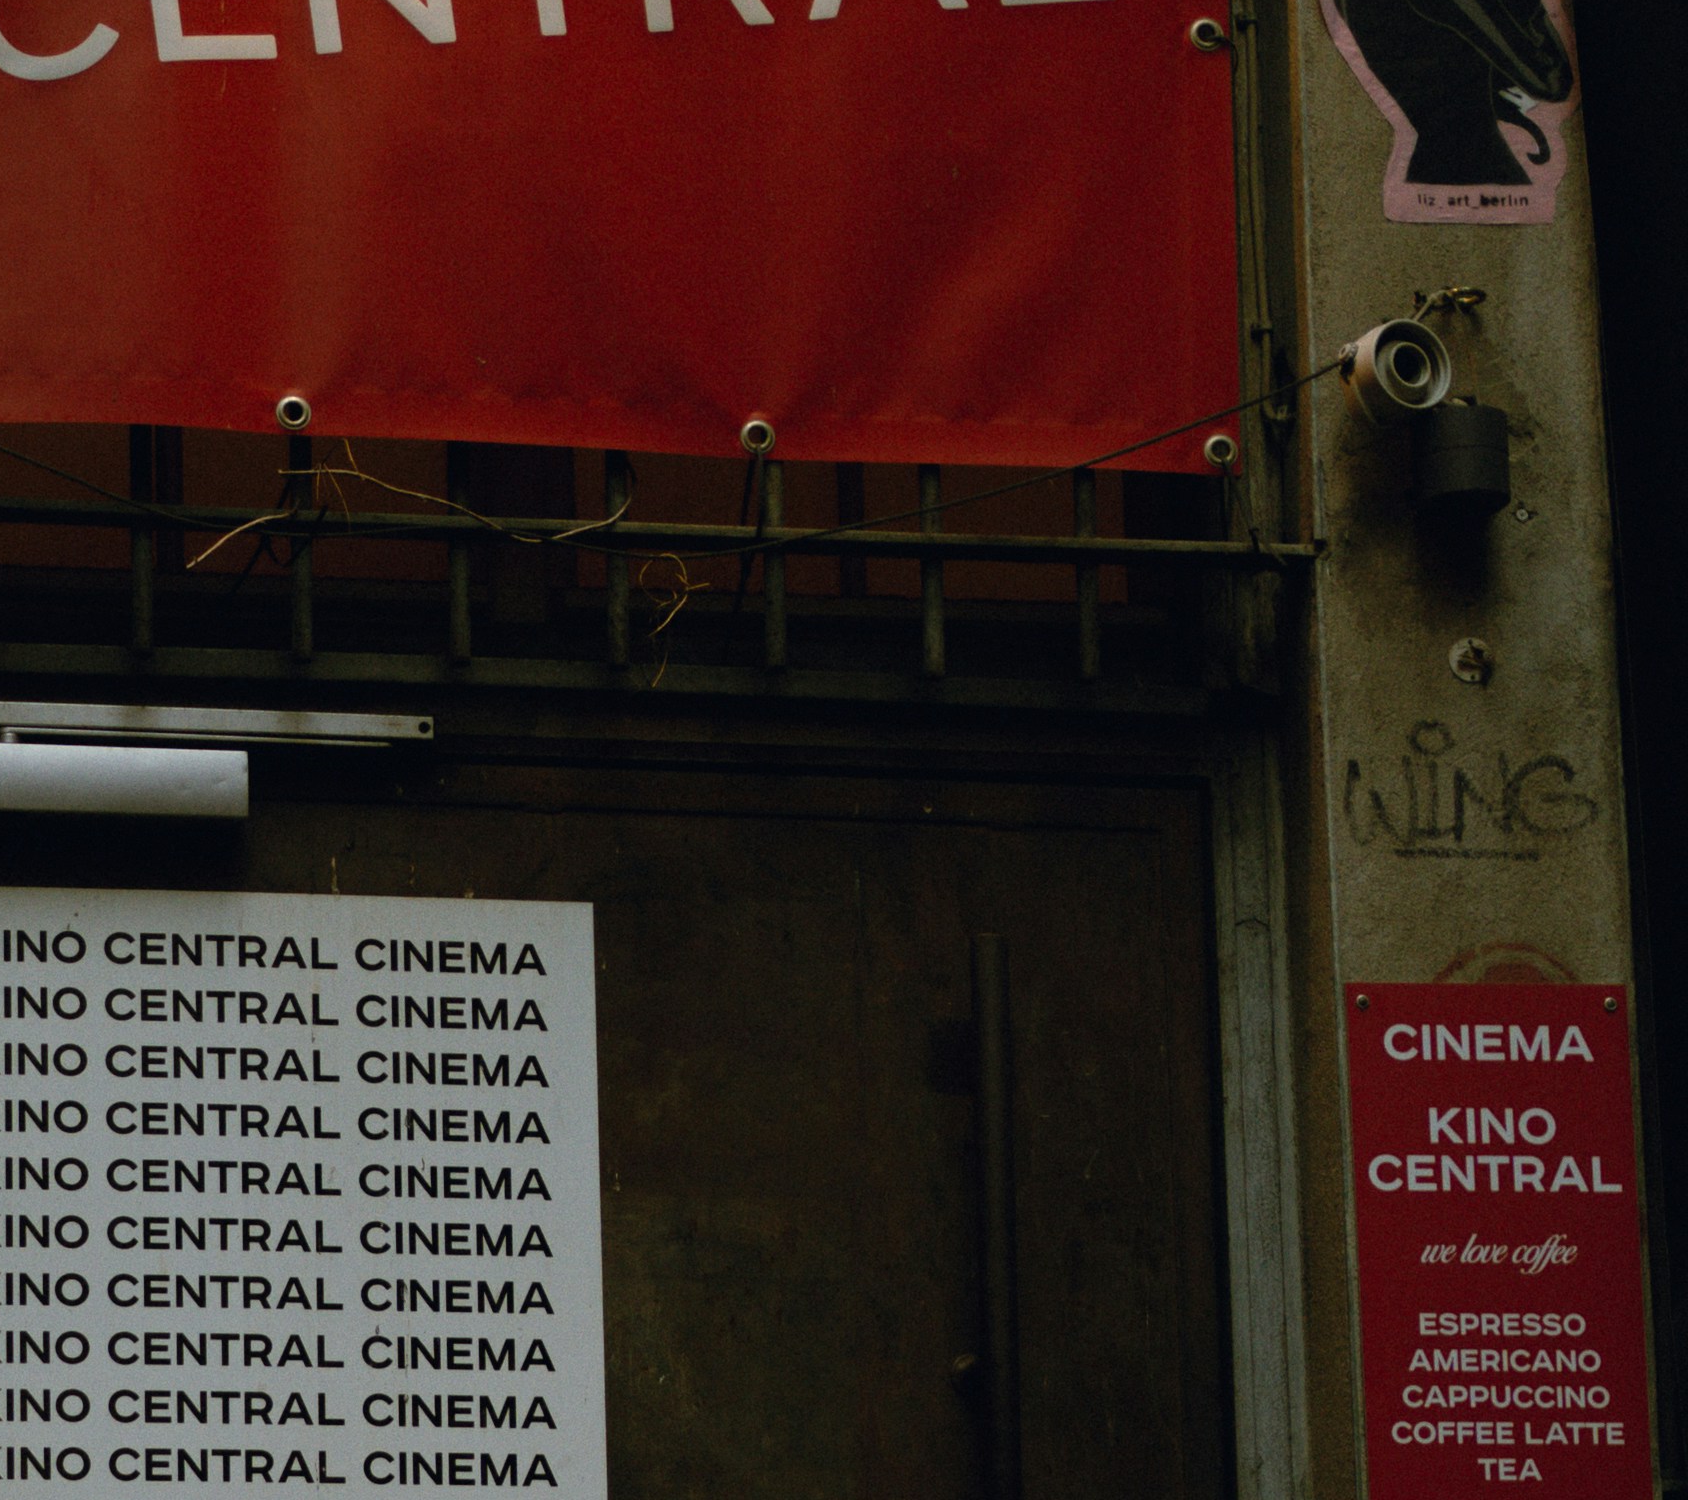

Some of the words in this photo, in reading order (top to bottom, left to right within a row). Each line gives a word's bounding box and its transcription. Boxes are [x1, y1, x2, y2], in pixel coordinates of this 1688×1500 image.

[104, 932, 337, 969] CENTRAL
[355, 939, 546, 975] CINEMA
[105, 988, 338, 1026] CENTRAL
[356, 995, 547, 1031] CINEMA
[1384, 1024, 1593, 1061] CINEMA
[105, 1045, 339, 1082] CENTRAL
[357, 1051, 548, 1087] CINEMA
[106, 1102, 340, 1139] CENTRAL
[358, 1108, 550, 1144] CINEMA
[1429, 1108, 1556, 1144] KINO
[107, 1159, 341, 1196] CENTRAL
[359, 1164, 551, 1200] CINEMA
[1369, 1155, 1622, 1192] CENTRAL
[107, 1216, 342, 1253] CENTRAL
[360, 1221, 552, 1257] CINEMA
[1421, 1241, 1455, 1264] we
[1460, 1234, 1507, 1264] love
[1512, 1235, 1578, 1275] coffee
[108, 1274, 343, 1310] CENTRAL
[361, 1279, 553, 1314] CINEMA
[1419, 1313, 1585, 1336] ESPRESSO
[108, 1332, 344, 1368] CENTRAL
[362, 1335, 555, 1371] CINEMA
[1409, 1349, 1601, 1372] AMERICANO
[108, 1390, 345, 1426] CENTRAL
[363, 1394, 556, 1429] CINEMA
[1403, 1385, 1610, 1408] CAPPUCCINO
[1392, 1421, 1514, 1444] COFFEE
[1525, 1422, 1624, 1445] LATTE
[109, 1448, 345, 1484] CENTRAL
[364, 1451, 557, 1487] CINEMA
[1478, 1458, 1541, 1481] TEA
